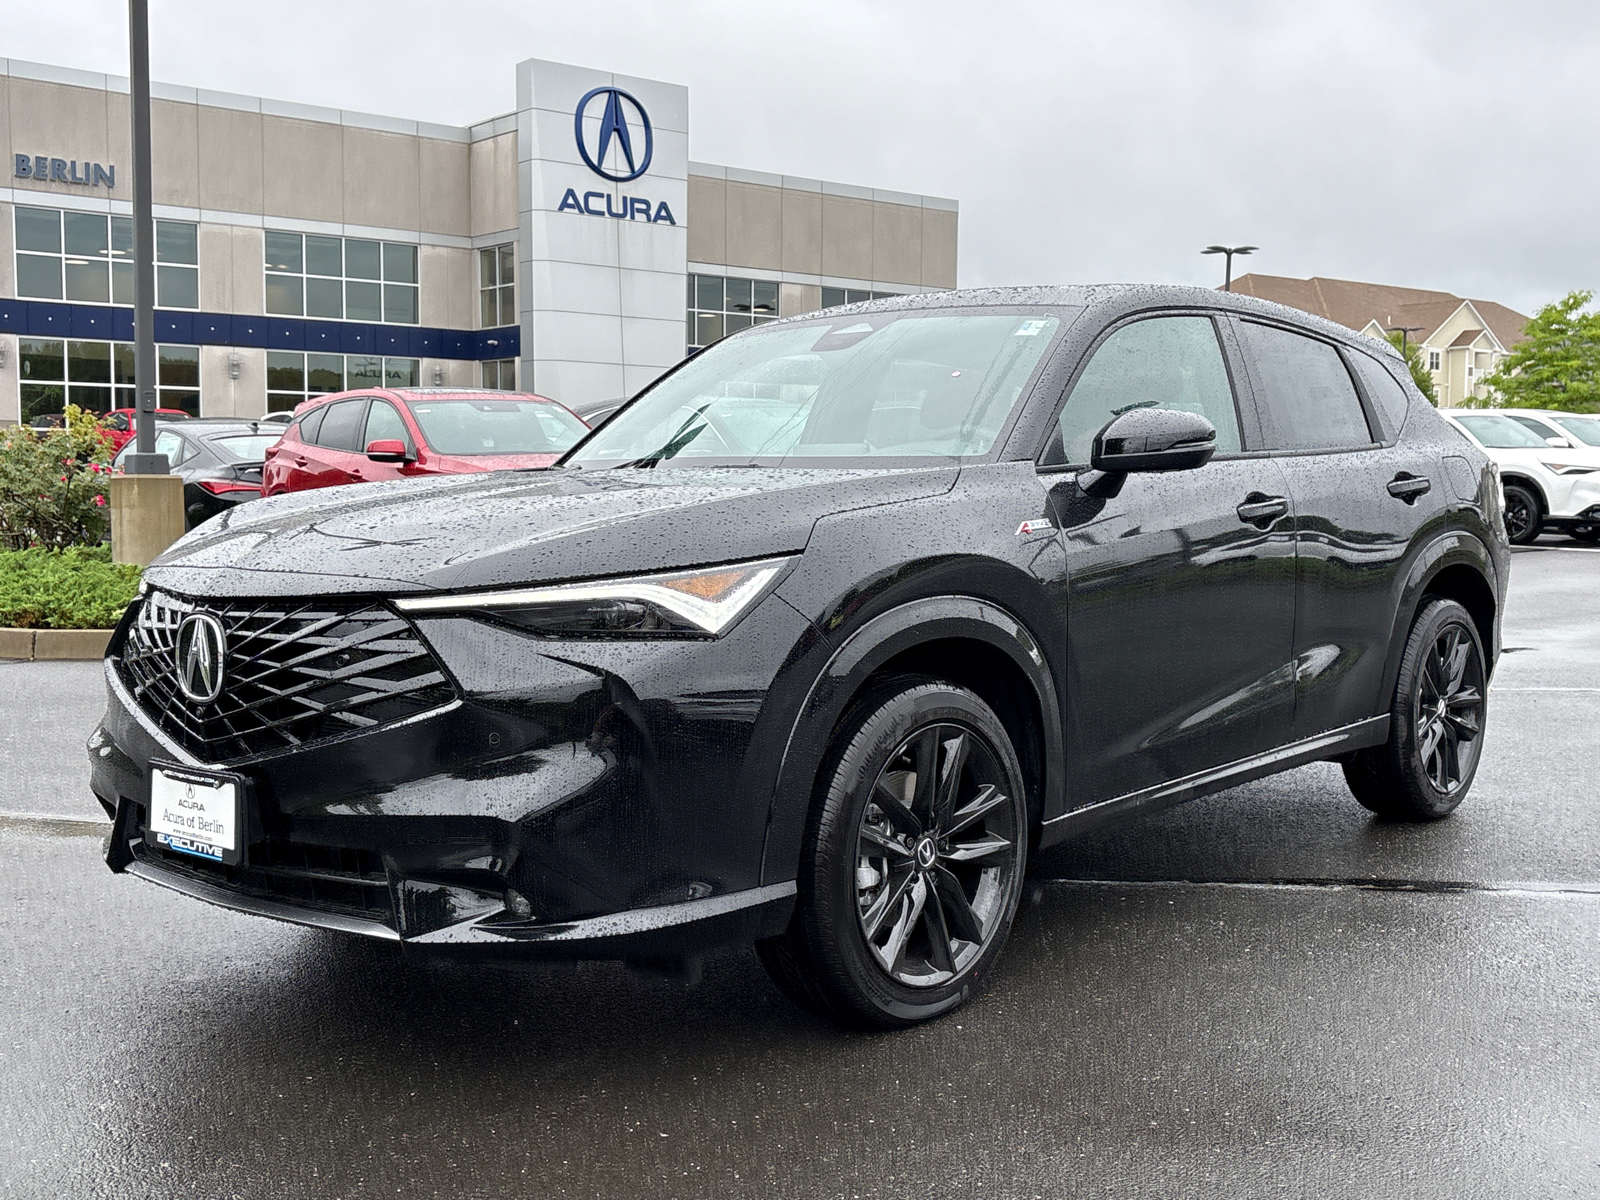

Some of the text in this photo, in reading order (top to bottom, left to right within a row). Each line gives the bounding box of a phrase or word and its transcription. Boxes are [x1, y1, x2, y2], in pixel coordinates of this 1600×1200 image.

[14, 153, 115, 188] BERLIN
[557, 188, 677, 225] ACURA
[178, 799, 206, 812] ACURA
[163, 808, 225, 835] Acura of Berlin
[157, 833, 223, 858] EXECUTIVE
